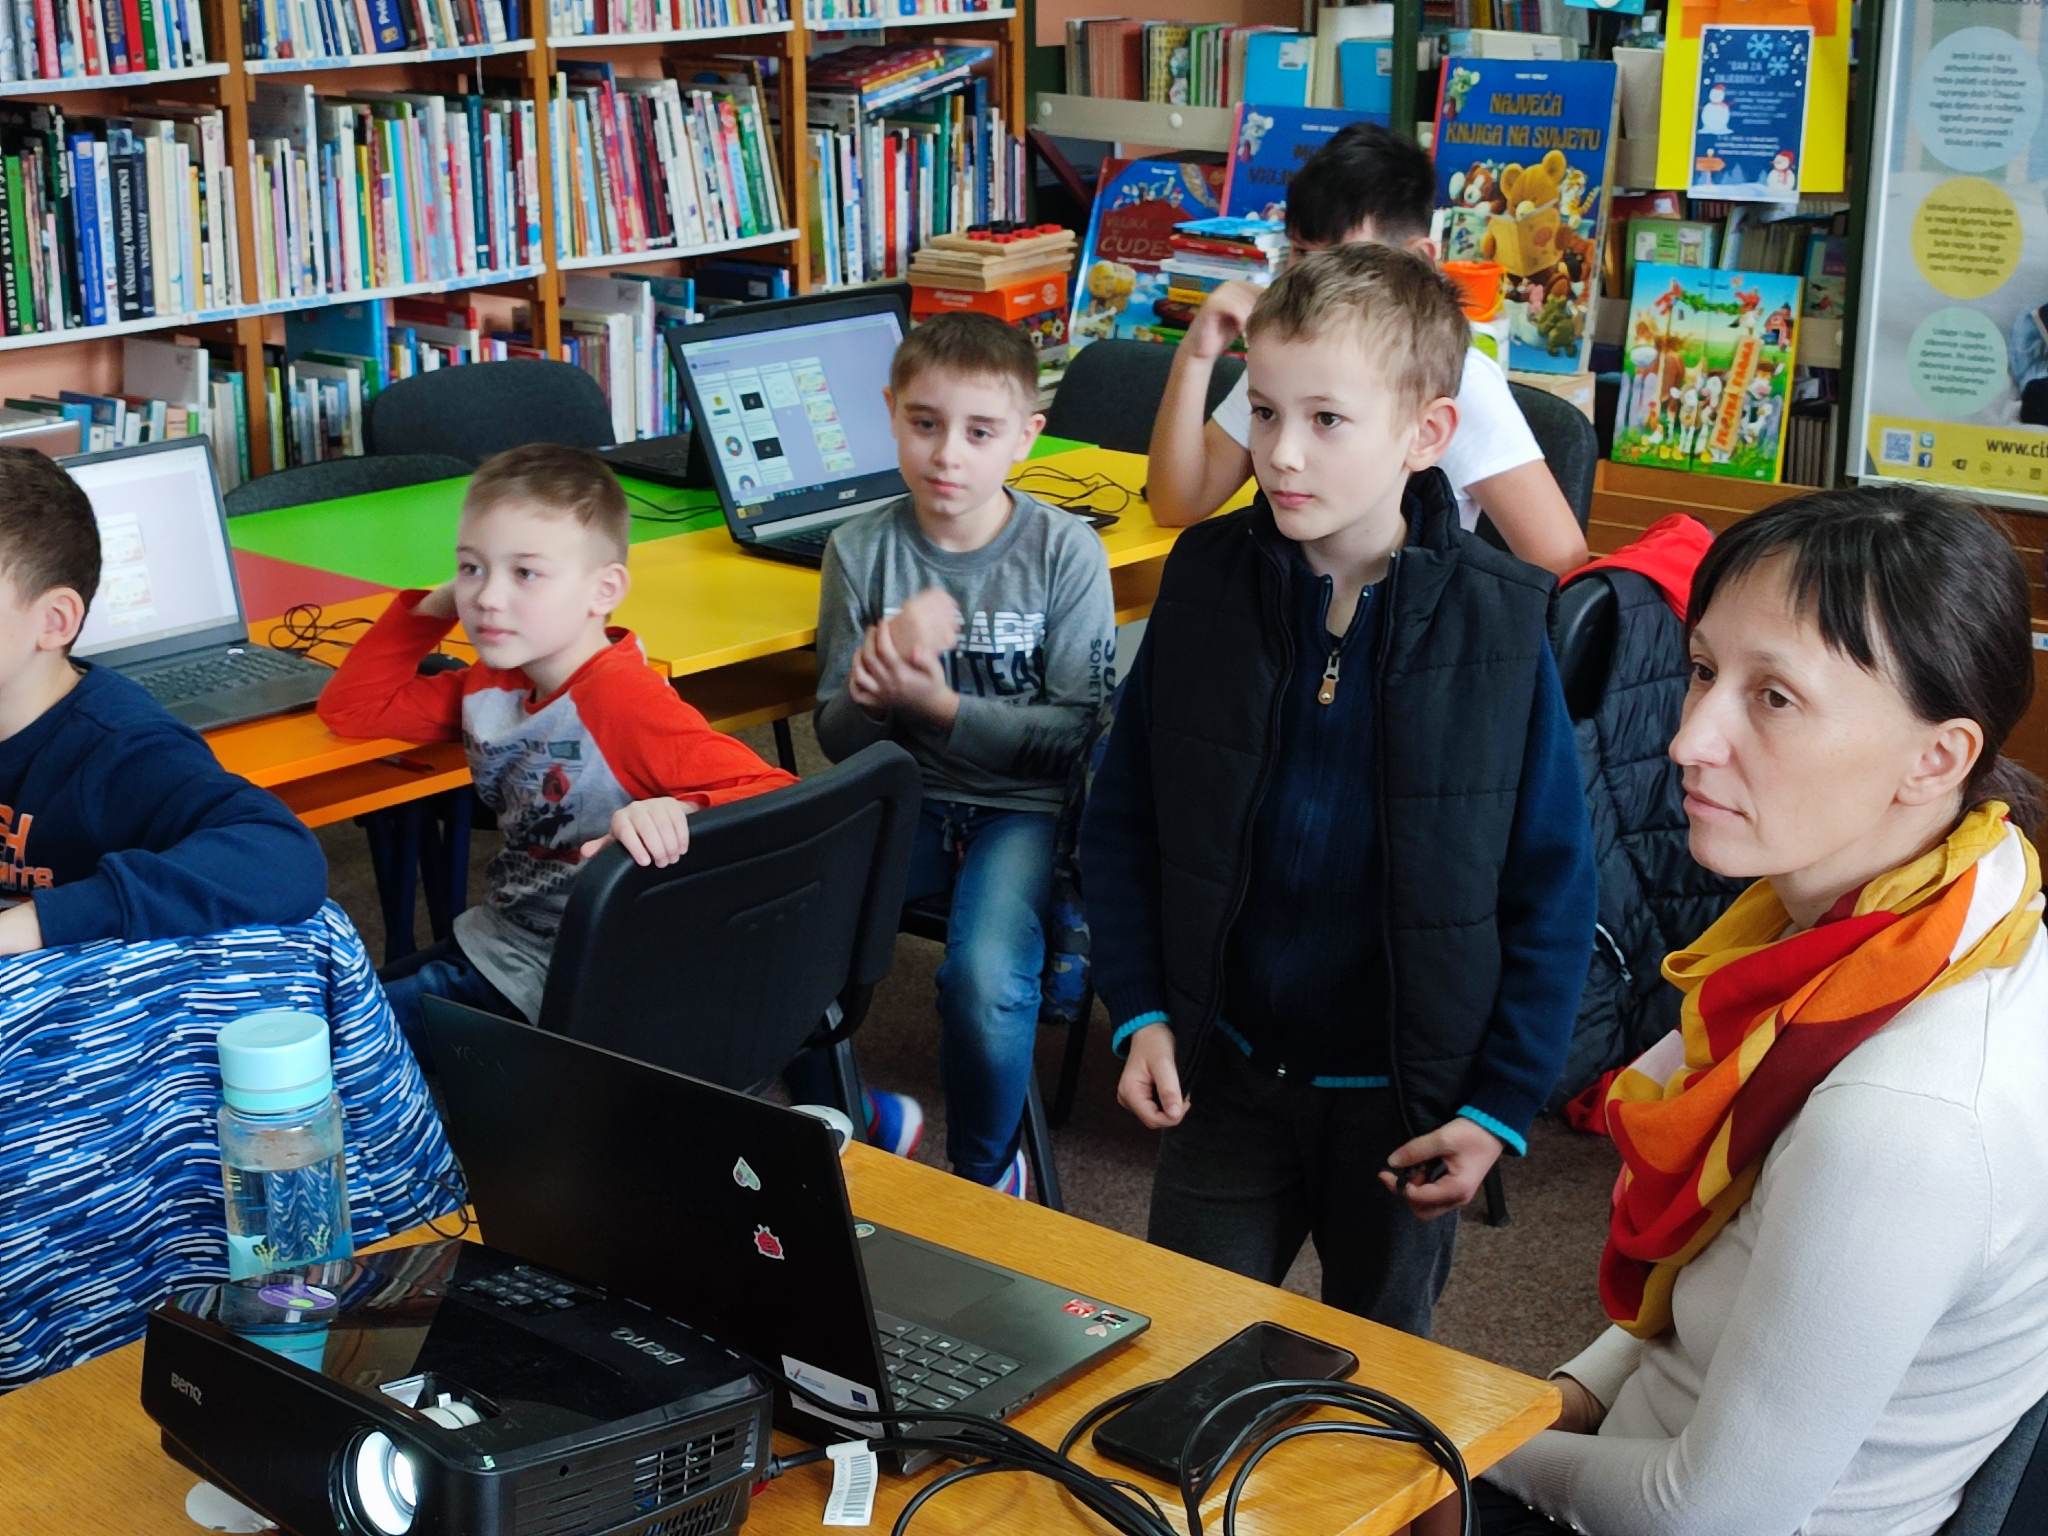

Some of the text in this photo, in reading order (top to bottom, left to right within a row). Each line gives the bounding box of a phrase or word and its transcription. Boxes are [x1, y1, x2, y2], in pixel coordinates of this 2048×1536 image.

[1489, 91, 1563, 117] NAJVEĆA
[1445, 122, 1602, 151] KNJIGA NA SVIJETU
[171, 1372, 202, 1406] BenQ
